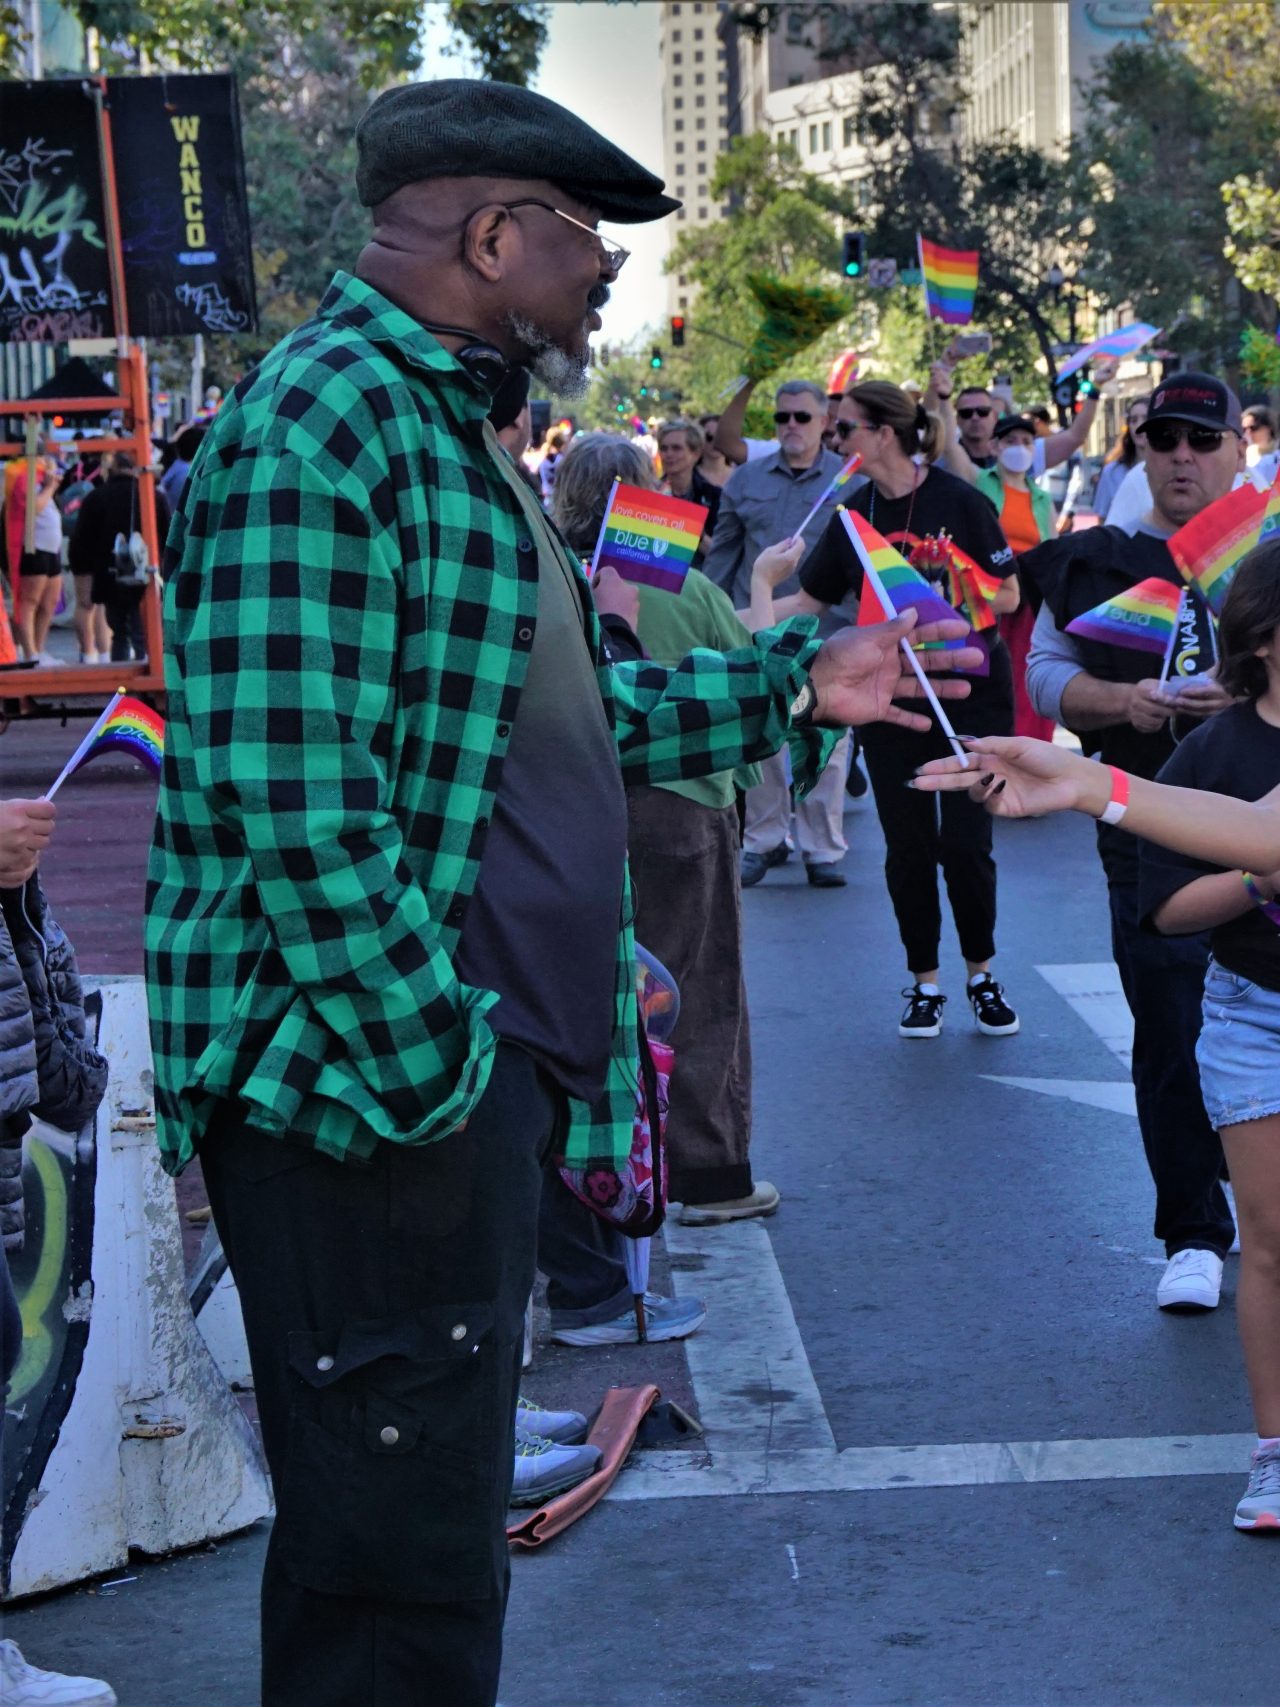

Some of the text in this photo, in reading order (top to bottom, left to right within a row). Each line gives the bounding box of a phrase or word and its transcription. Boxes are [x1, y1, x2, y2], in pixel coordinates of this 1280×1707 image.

[170, 115, 206, 248] WANCO
[614, 503, 633, 516] love
[635, 511, 668, 527] covers
[614, 528, 649, 551] blue
